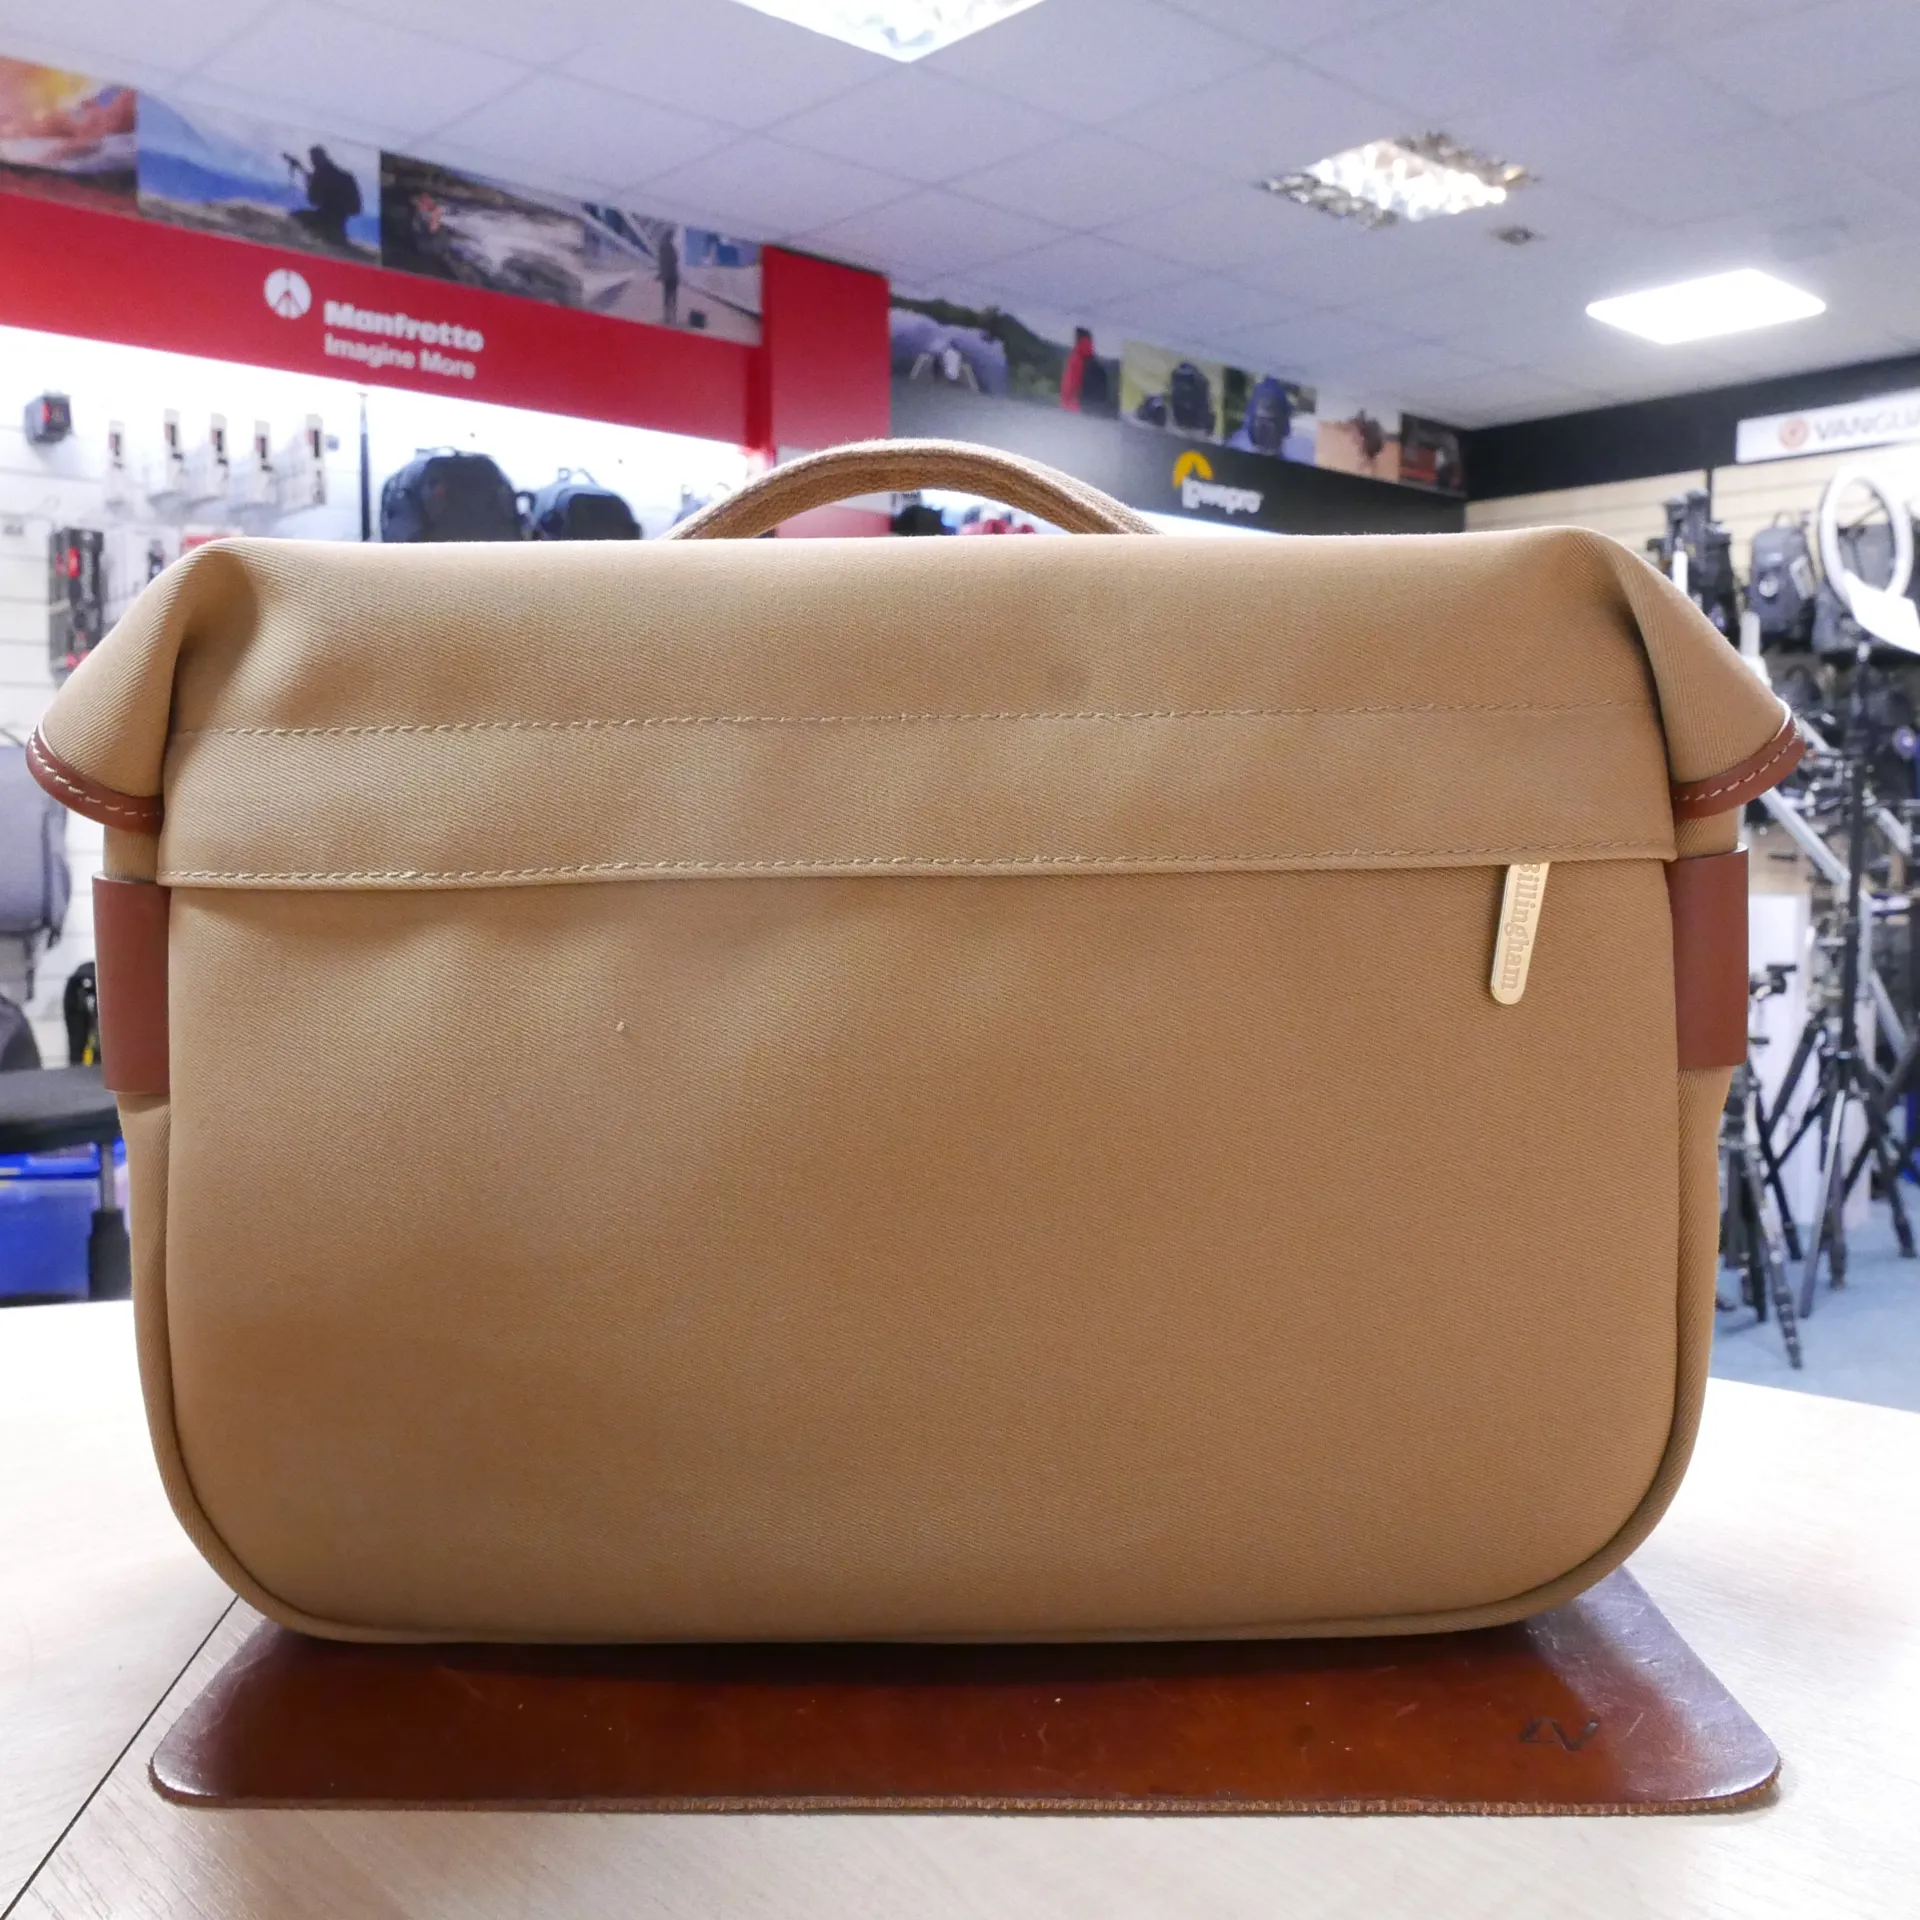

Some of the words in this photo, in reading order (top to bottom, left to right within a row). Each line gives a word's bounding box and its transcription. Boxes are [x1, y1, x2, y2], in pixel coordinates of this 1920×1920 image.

[323, 300, 485, 352] Manfrotto
[323, 332, 416, 369] Imagine
[419, 347, 477, 380] More
